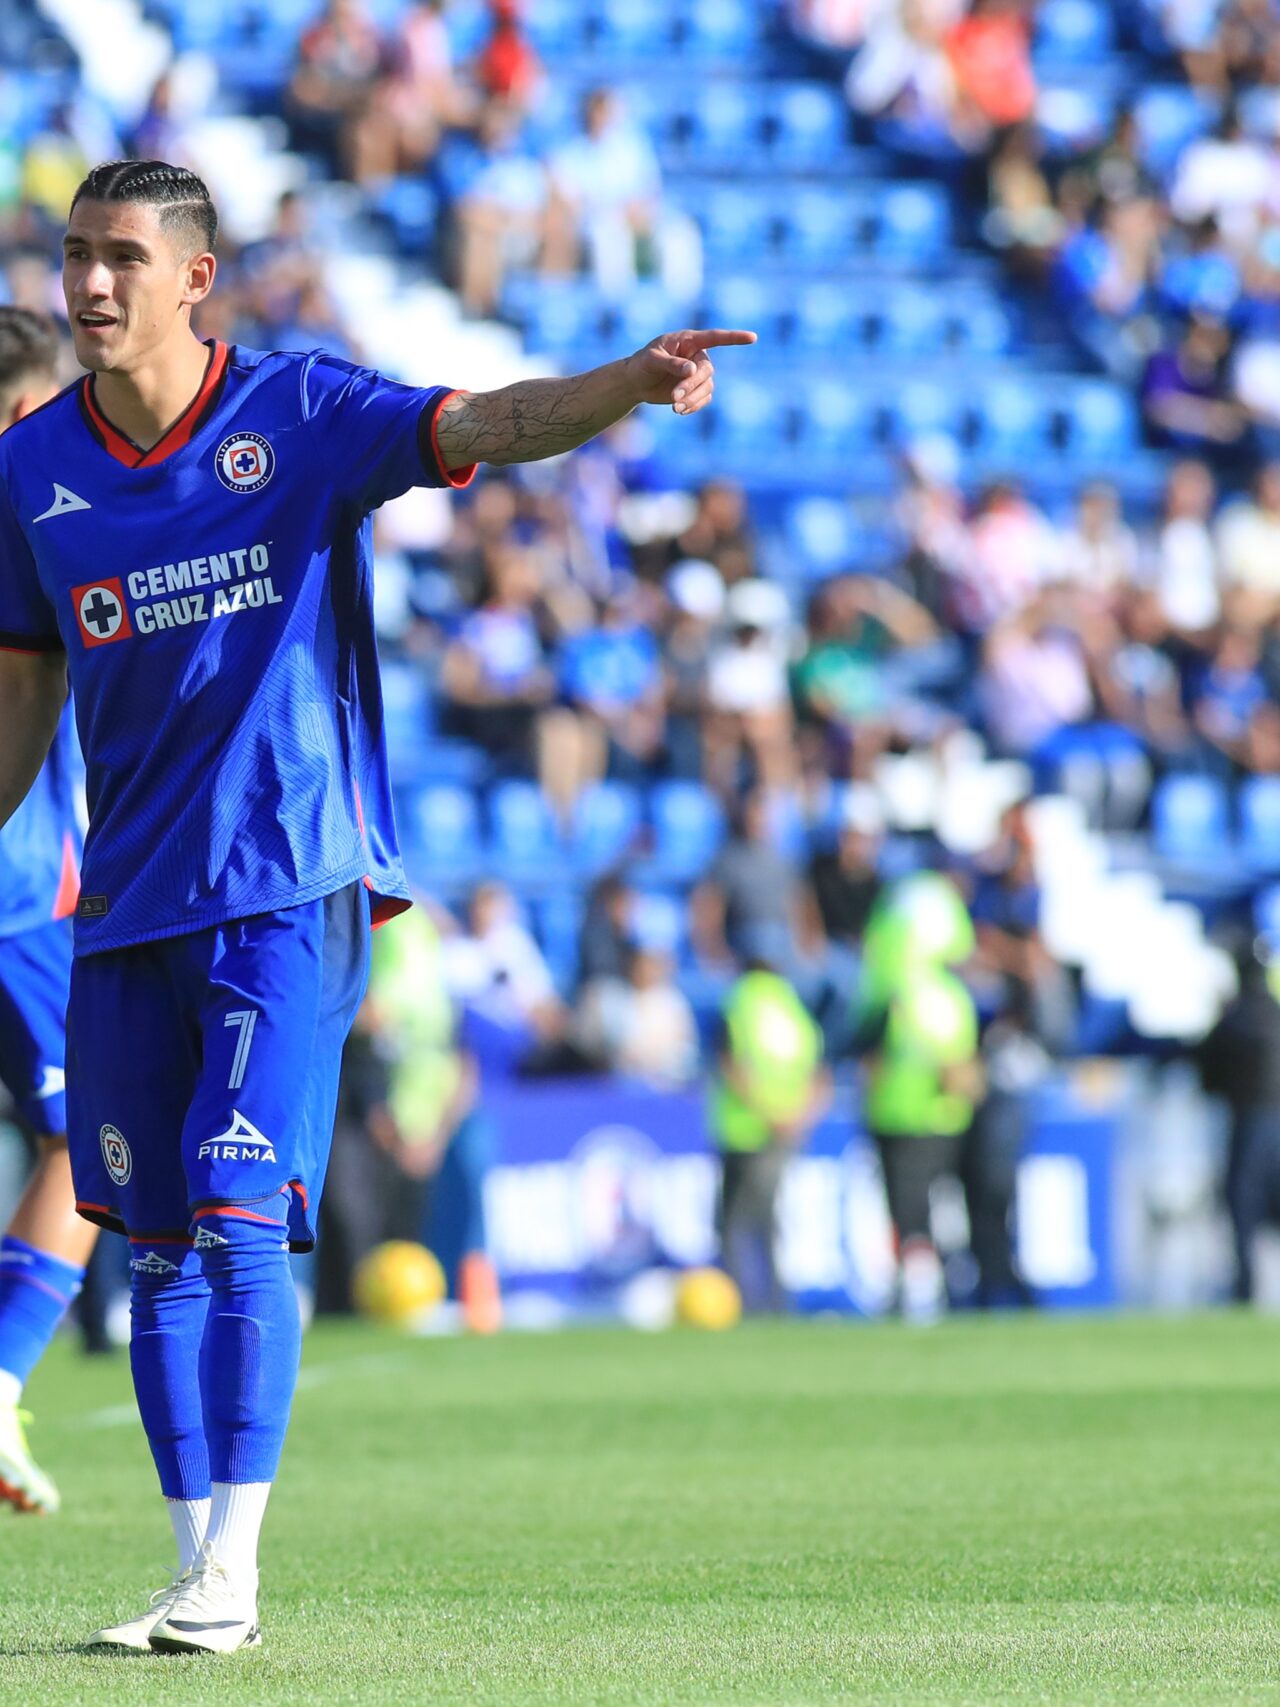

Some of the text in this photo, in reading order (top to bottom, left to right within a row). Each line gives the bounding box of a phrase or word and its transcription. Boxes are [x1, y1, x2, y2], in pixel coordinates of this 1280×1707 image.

[127, 543, 269, 601] CEMENTO
[135, 576, 283, 634] CRUZ AZUL
[224, 1010, 258, 1089] 7
[198, 1146, 277, 1163] PIRMA
